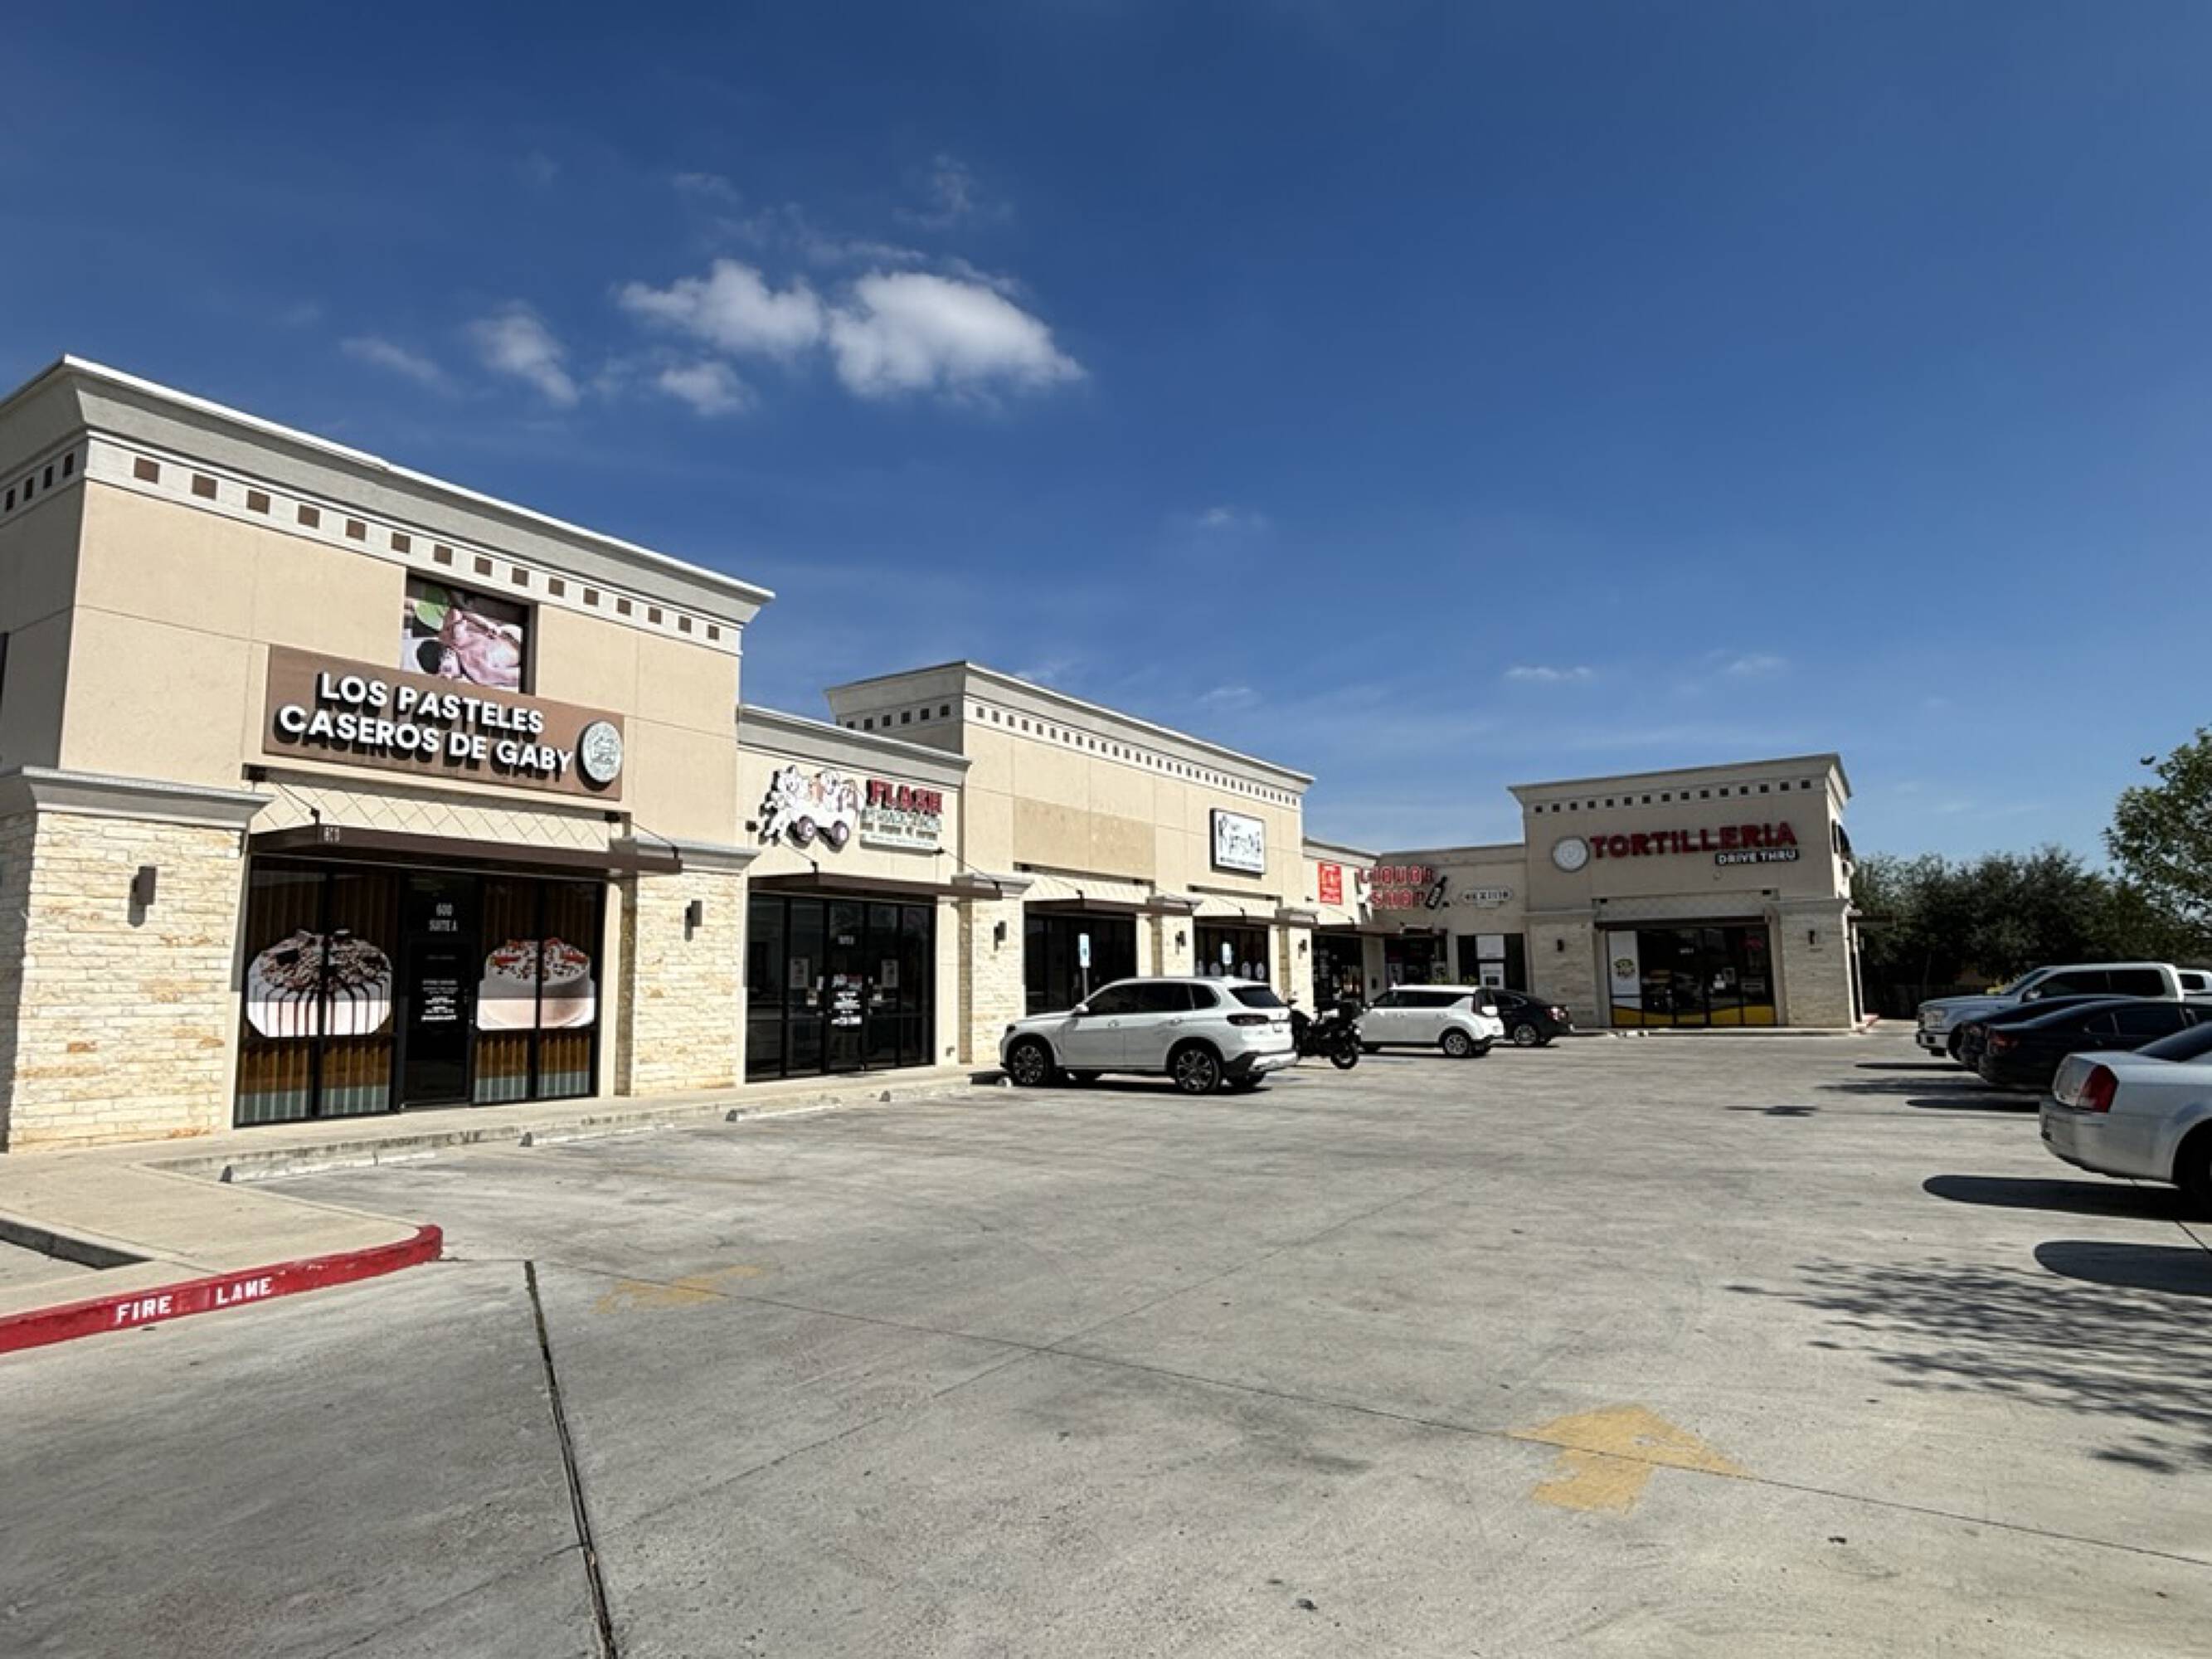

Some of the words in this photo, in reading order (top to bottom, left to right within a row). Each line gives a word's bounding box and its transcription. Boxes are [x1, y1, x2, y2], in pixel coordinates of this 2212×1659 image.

[320, 672, 387, 708] LOS
[398, 686, 544, 734] PASTELES
[279, 705, 439, 752] CASEROS
[450, 732, 487, 759] DE
[496, 740, 574, 772] GABY
[868, 780, 943, 813] FLASH
[1590, 820, 1798, 859] TORTILLERIA
[1719, 852, 1757, 865] DRIVE
[1760, 850, 1796, 862] THRU
[116, 1296, 173, 1324] FIRE
